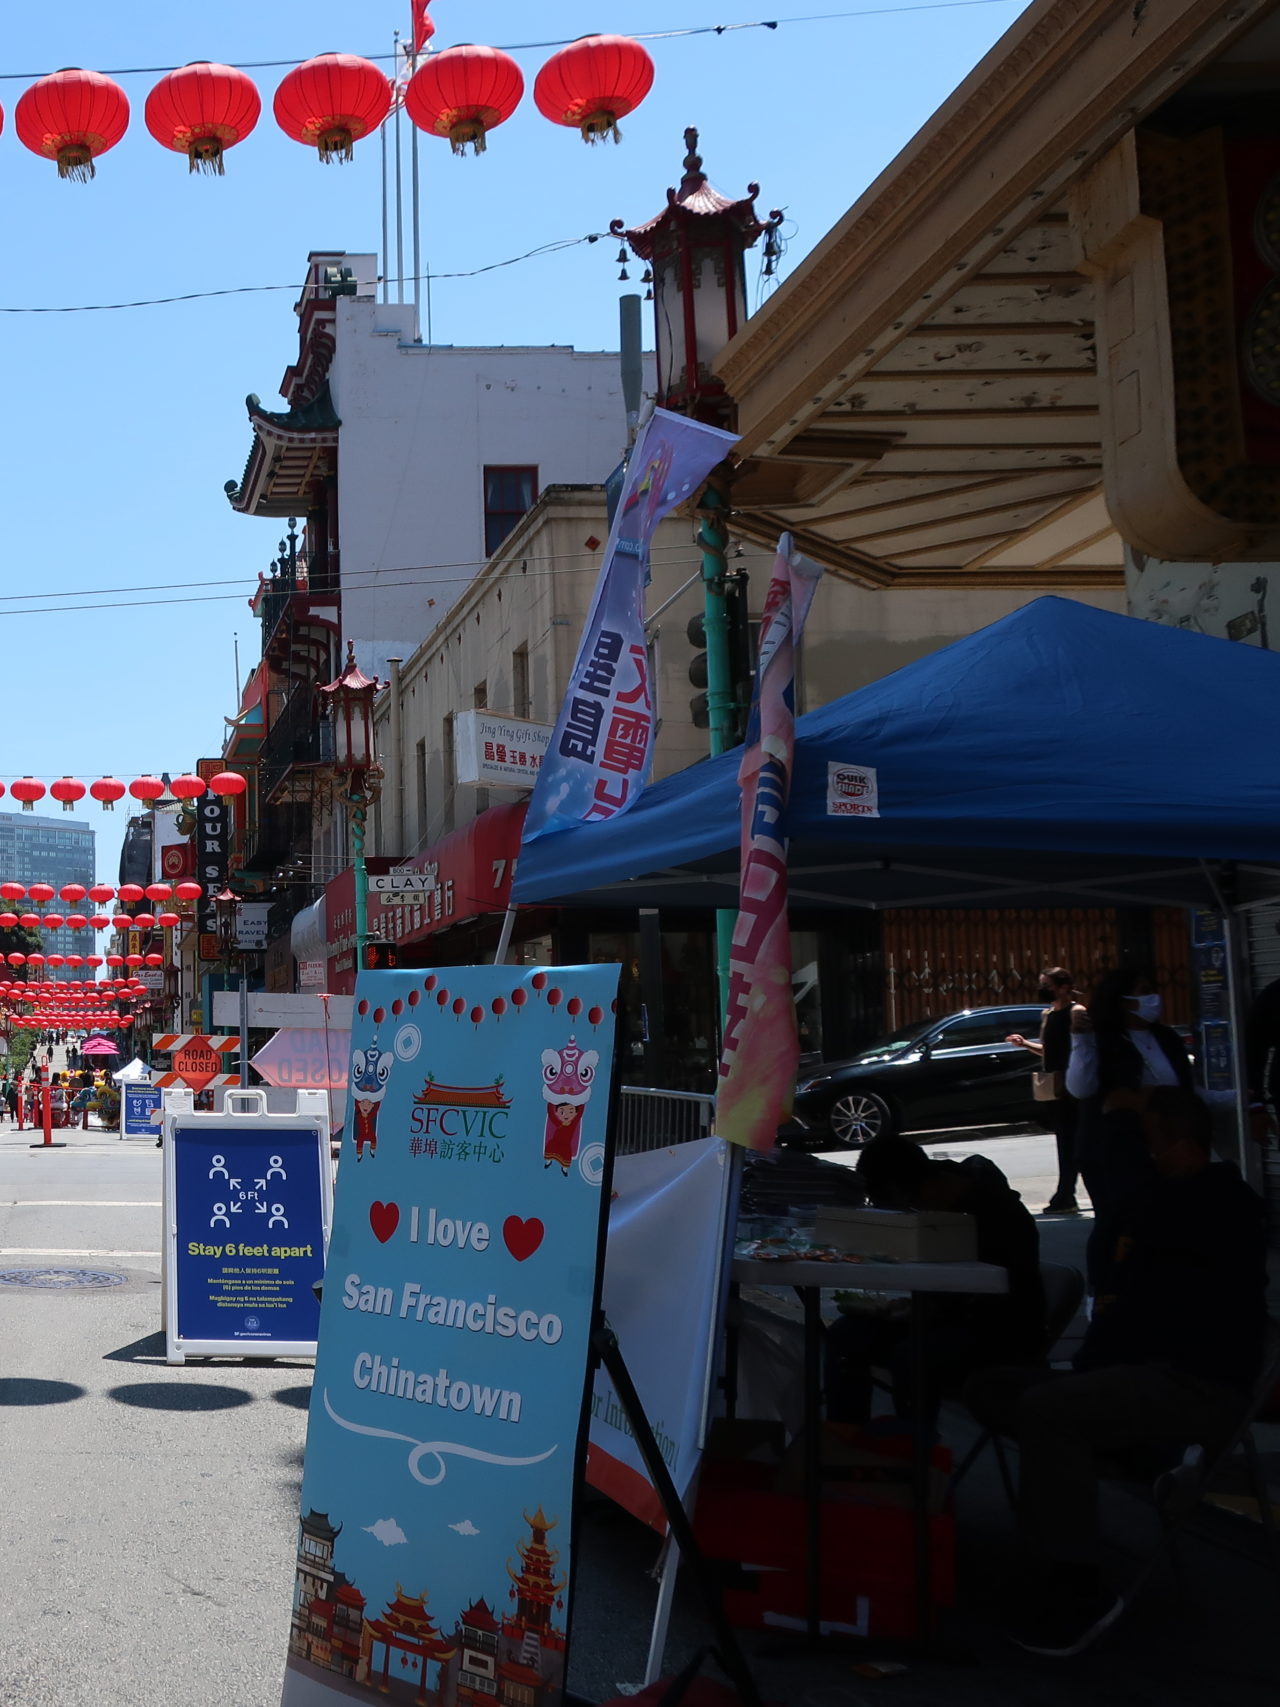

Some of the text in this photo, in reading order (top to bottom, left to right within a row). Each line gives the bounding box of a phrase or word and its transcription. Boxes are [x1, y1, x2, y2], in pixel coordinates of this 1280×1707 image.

[480, 723, 496, 738] Jing
[497, 726, 514, 742] Ying
[516, 728, 531, 743] Gift
[837, 773, 868, 784] QUIK
[832, 801, 873, 813] SPORTS
[375, 877, 429, 889] CLAY
[184, 1049, 213, 1060] ROAD
[178, 1060, 218, 1073] CLOSED
[410, 1106, 509, 1139] SFCVIC
[409, 1137, 505, 1163] 華埠訪客中心
[239, 1191, 259, 1200] 6 Ft
[410, 1206, 490, 1252] I love
[188, 1242, 313, 1259] Stay 6 feet apart
[342, 1273, 563, 1345] San Francisco
[353, 1352, 521, 1423] Chinatown
